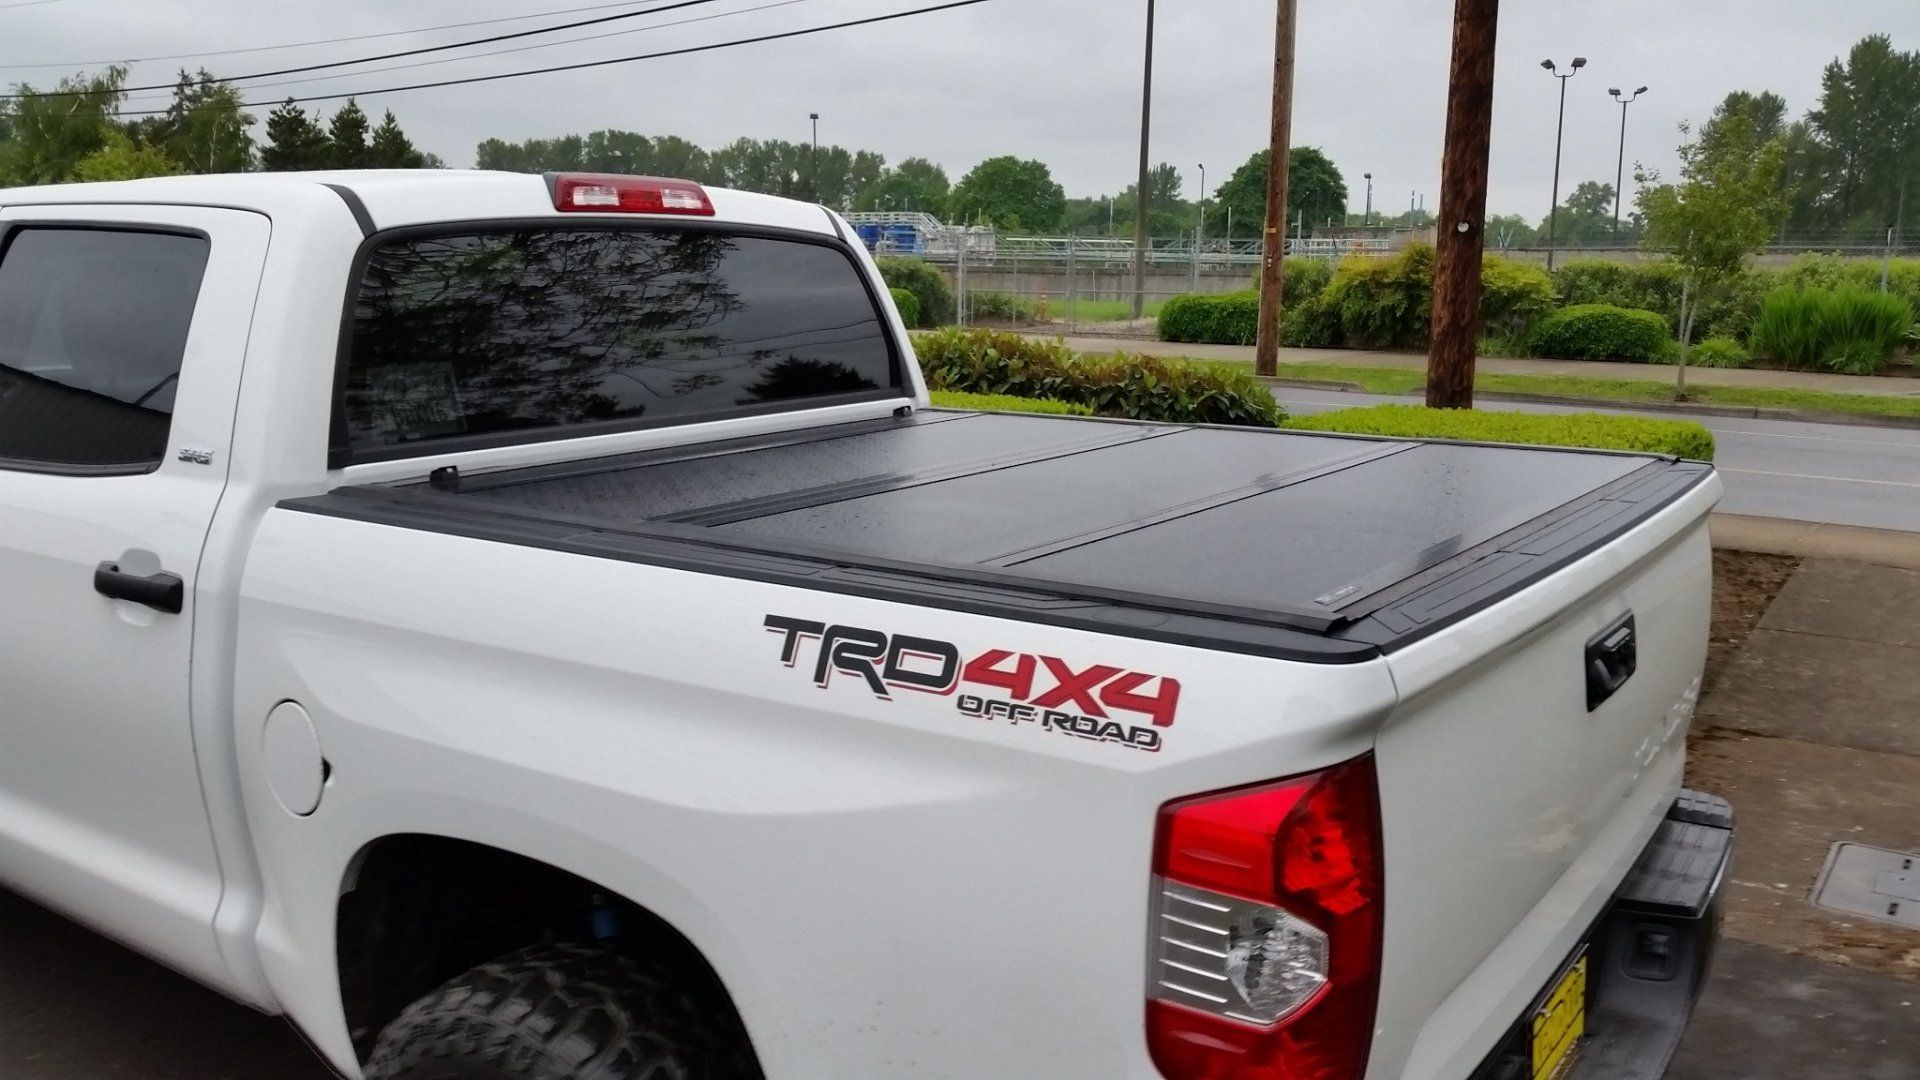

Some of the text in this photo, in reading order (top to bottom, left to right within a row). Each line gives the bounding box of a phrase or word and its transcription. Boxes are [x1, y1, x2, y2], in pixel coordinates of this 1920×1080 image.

[763, 614, 962, 701] TRD
[956, 694, 1162, 752] OFF ROAD
